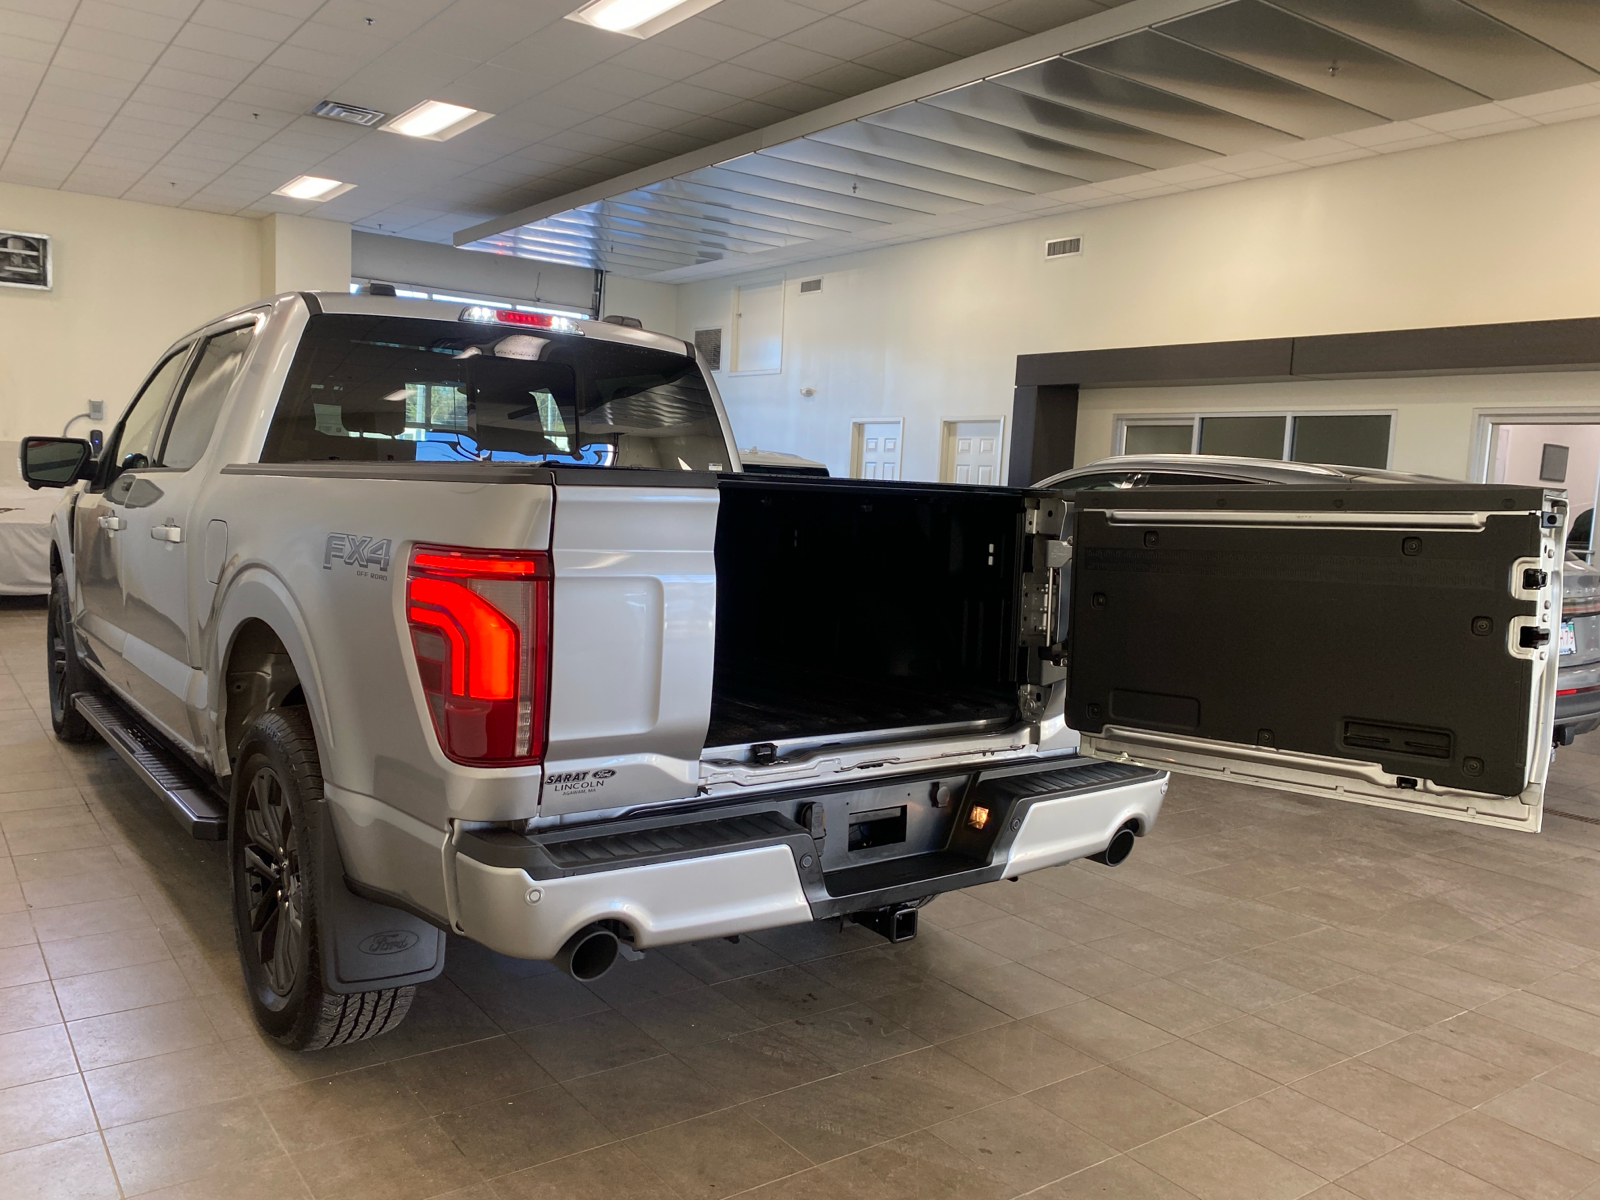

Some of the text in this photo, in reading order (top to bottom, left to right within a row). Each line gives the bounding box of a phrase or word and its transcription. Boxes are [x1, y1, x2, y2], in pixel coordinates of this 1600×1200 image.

[323, 532, 392, 572] FX4
[370, 572, 388, 582] ROAD
[545, 771, 590, 785] SARAT
[554, 780, 604, 792] LINCOLN
[368, 933, 409, 953] Ford
